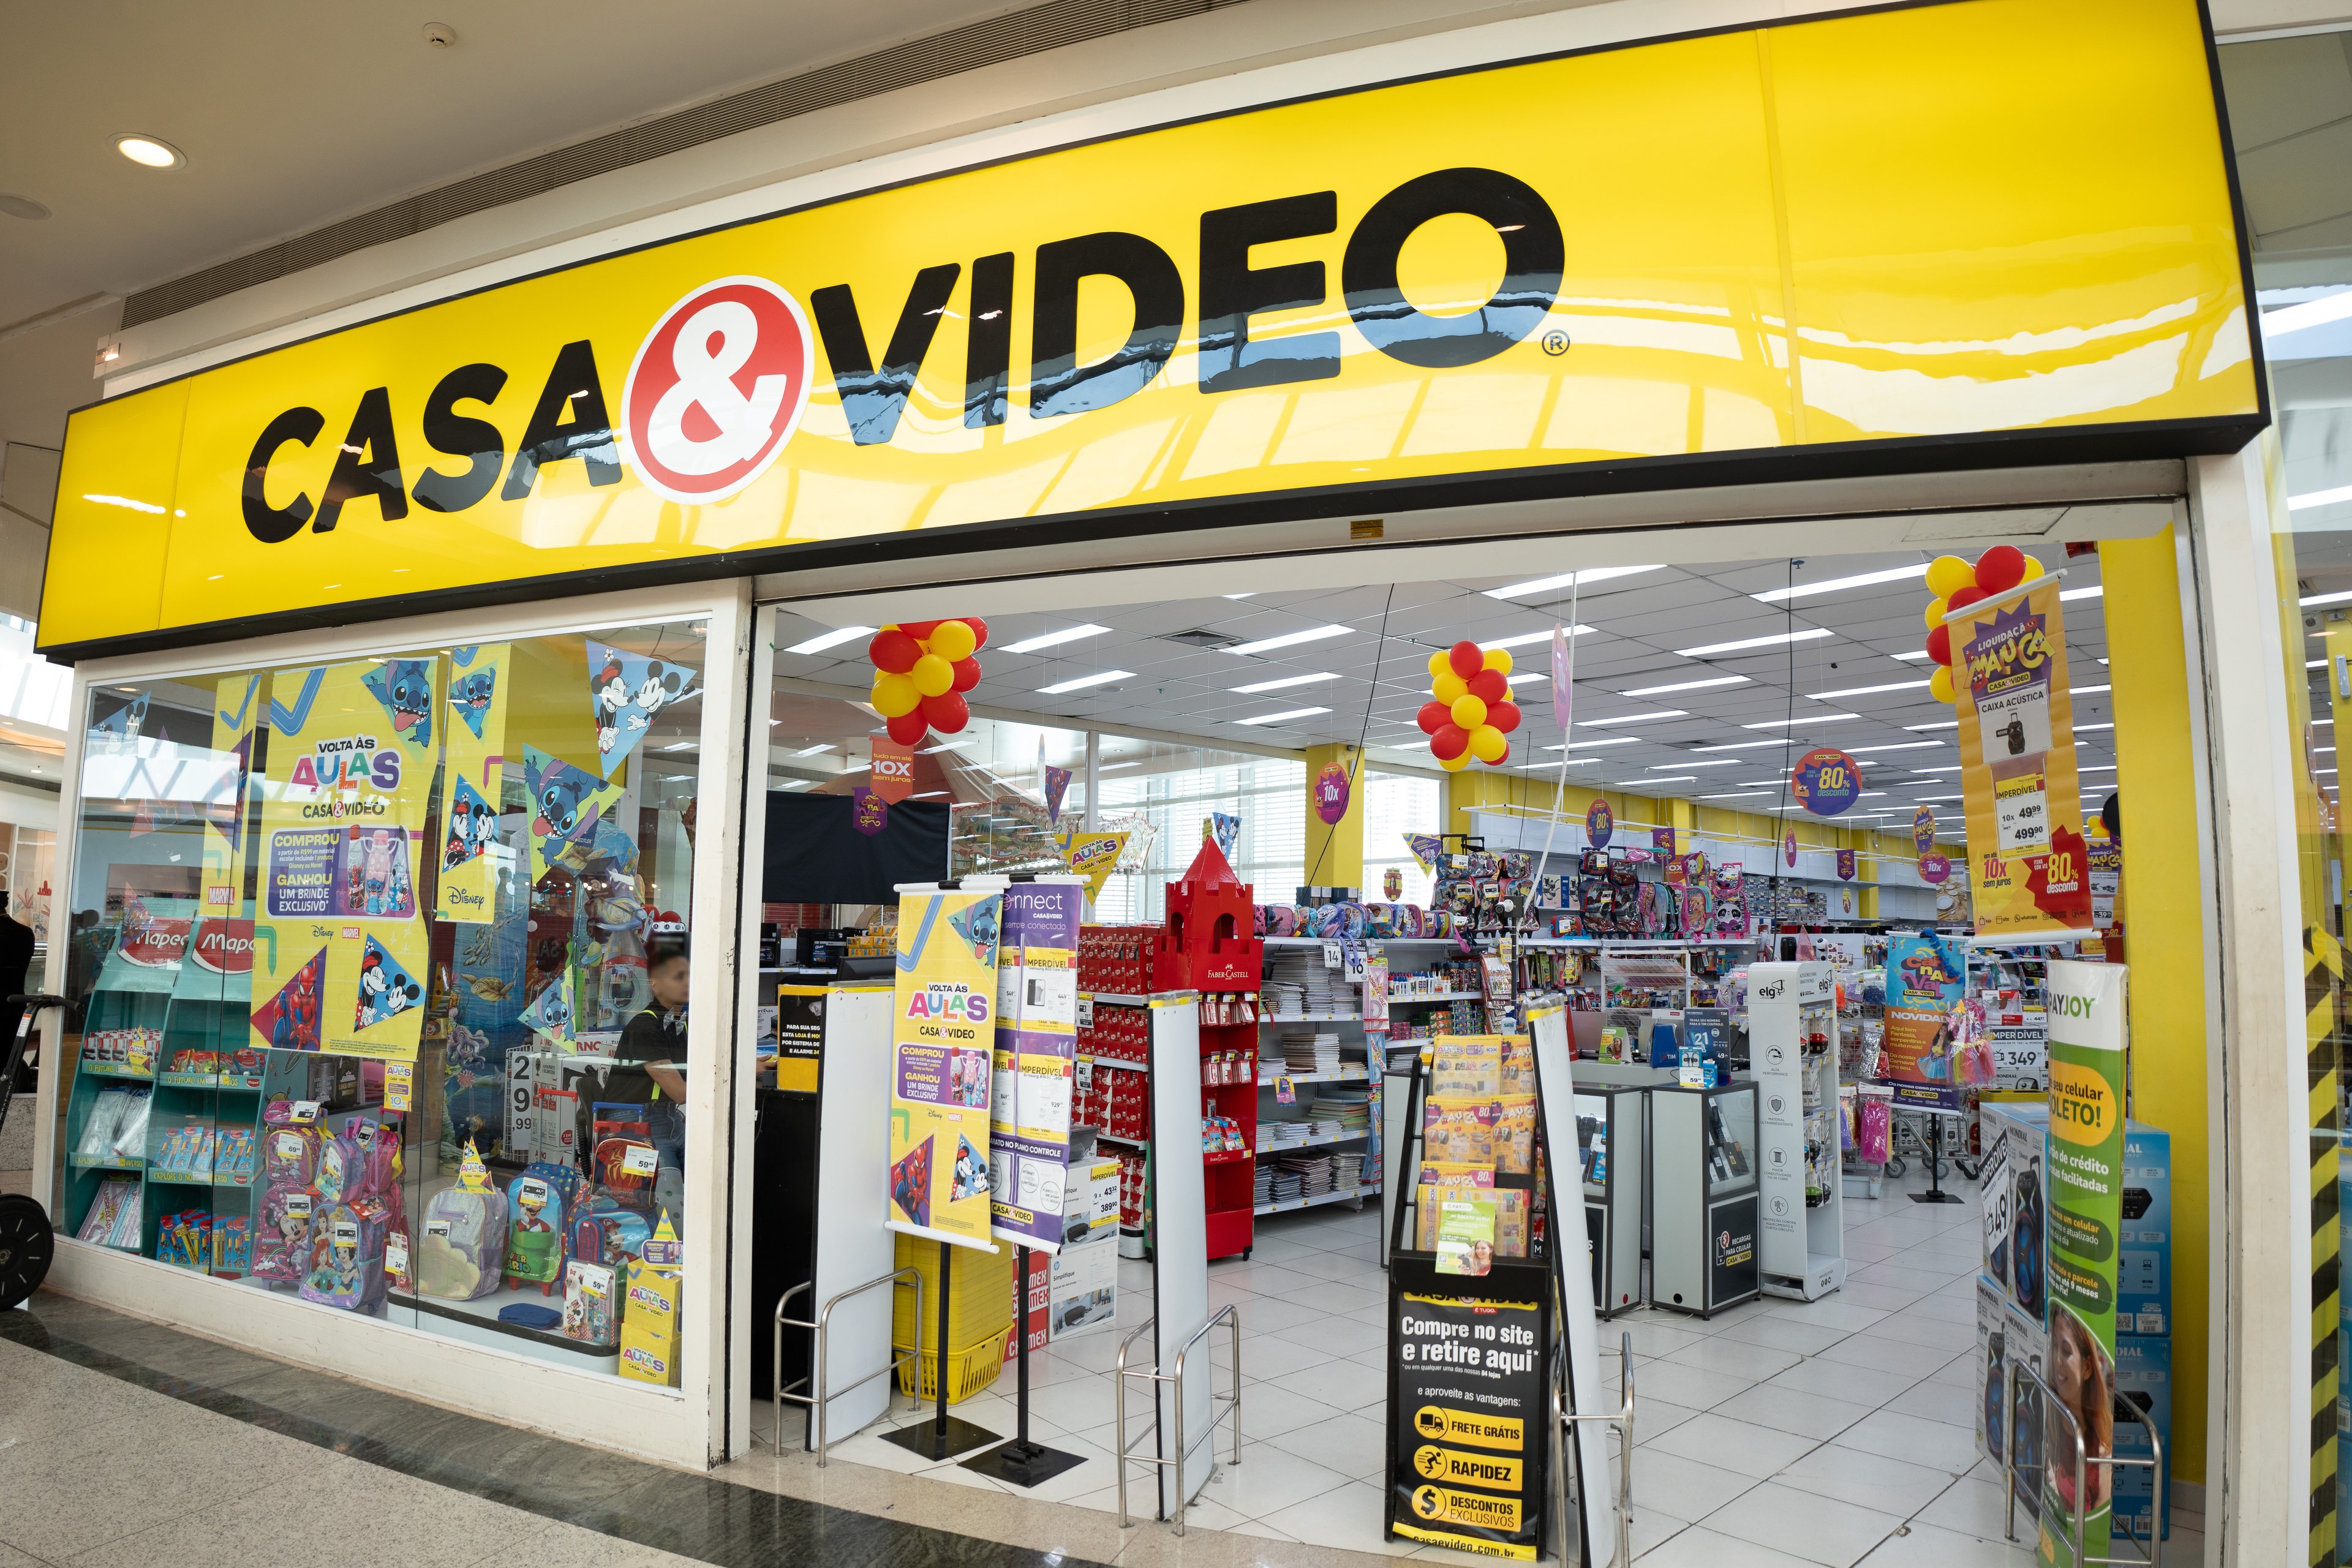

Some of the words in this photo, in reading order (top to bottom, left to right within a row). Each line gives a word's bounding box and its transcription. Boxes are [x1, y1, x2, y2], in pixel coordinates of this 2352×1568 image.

[241, 167, 1565, 544] CASA&VIDEO
[1989, 674, 2029, 691] CASA&VIDEO
[1982, 701, 2004, 713] CAIXA
[2006, 691, 2044, 707] ACÚSTICA
[319, 741, 353, 753] VOLTA
[355, 737, 375, 749] ÀS
[288, 752, 399, 793] AULAS
[873, 761, 911, 776] 10X
[1325, 785, 1339, 801] 10x
[1817, 788, 1849, 796] desconto
[1997, 785, 2037, 800] IMPERDÍVEL
[303, 801, 385, 818] CASA&VIDEO
[275, 834, 339, 847] COMPROU
[1072, 840, 1117, 865] AULAS
[1081, 856, 1112, 870] CASA&VIDEO
[1928, 863, 1941, 872] 10x
[1984, 858, 2007, 878] 10x
[277, 873, 332, 885] GANHOU
[1996, 879, 2011, 888] juros
[2047, 880, 2078, 894] desconto
[280, 889, 295, 899] UM
[298, 888, 329, 899] BRINDE
[343, 928, 360, 938] MARVEL
[1025, 959, 1068, 968] IMPERDÍVEL
[1328, 951, 1338, 962] 14
[1208, 970, 1248, 978] FABER-CASTELL
[1759, 987, 1775, 998] elg
[1819, 979, 1828, 993] elg
[908, 993, 987, 1021] AULAS
[2049, 995, 2095, 1019] PAYJOY
[920, 1026, 974, 1039] CASA&VIDEO
[1694, 1032, 1708, 1045] 21
[902, 1047, 944, 1058] COMPROU
[2008, 1052, 2036, 1065] 349
[513, 1056, 529, 1079] 2
[1019, 1065, 1062, 1076] IMPERDÍVEL
[905, 1072, 940, 1083] GANHOU
[2053, 1081, 2063, 1092] seu
[2065, 1082, 2103, 1101] celular
[514, 1088, 530, 1112] 9
[2010, 1126, 2027, 1142] MONDIAL
[1014, 1143, 1028, 1152] PLANO
[1030, 1147, 1061, 1157] CONTROLE
[2060, 1153, 2068, 1164] de
[2070, 1155, 2109, 1175] crédito
[2061, 1170, 2108, 1193] facilitadas
[992, 1204, 1031, 1221] CASA&VIDEO
[2064, 1215, 2071, 1224] um
[2074, 1219, 2099, 1233] celular
[1732, 1234, 1751, 1245] RECARGAS
[2067, 1227, 2098, 1245] atualizado
[1726, 1246, 1735, 1256] PARA
[1736, 1243, 1751, 1253] CELULAR
[1727, 1253, 1751, 1264] CASA&VIDEO
[1054, 1271, 1074, 1281] Simplifique
[2073, 1273, 2098, 1288] parcele
[629, 1287, 670, 1311] AULAS
[1980, 1286, 1999, 1306] MONDIAL
[2076, 1286, 2098, 1298] meses
[1402, 1316, 1469, 1340] Compre
[1474, 1324, 1496, 1341] no
[1501, 1325, 1534, 1346] site
[2009, 1314, 2027, 1337] MONDIAL
[623, 1348, 665, 1372] AULAS
[1403, 1344, 1415, 1360] e
[1422, 1340, 1480, 1365] retire
[1425, 1387, 1463, 1399] aproveite
[1464, 1392, 1474, 1400] as
[1476, 1393, 1521, 1407] vantagens:
[1452, 1421, 1481, 1434] FRETE
[1484, 1425, 1520, 1439] GRÁTIS
[1452, 1460, 1511, 1482] RAPIDEZ
[1451, 1496, 1513, 1515] DESCONTOS
[1450, 1509, 1514, 1528] EXCLUSIVOS
[1413, 1536, 1515, 1557] casaevideo.com.br
